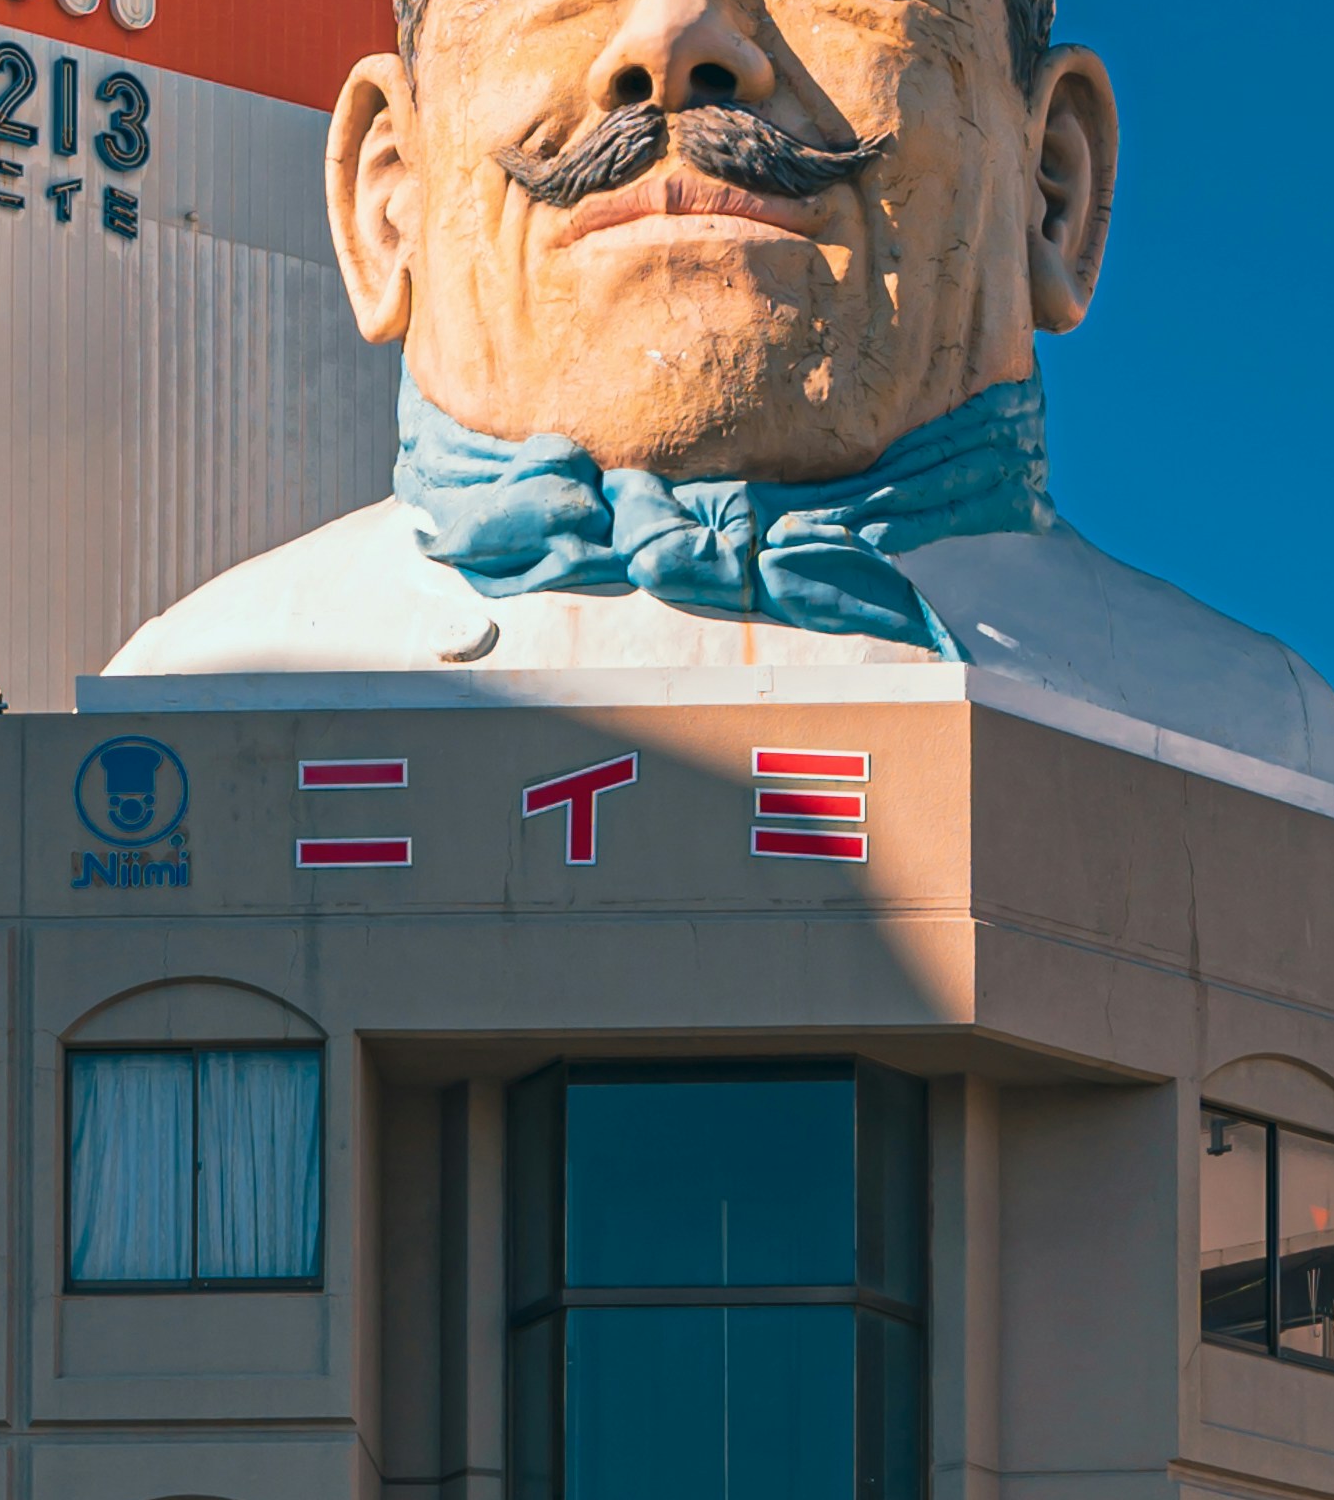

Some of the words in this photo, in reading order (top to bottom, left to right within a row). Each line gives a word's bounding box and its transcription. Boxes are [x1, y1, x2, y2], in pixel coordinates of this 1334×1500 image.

[296, 747, 869, 866] ニイミ
[71, 834, 190, 888] Niimi
